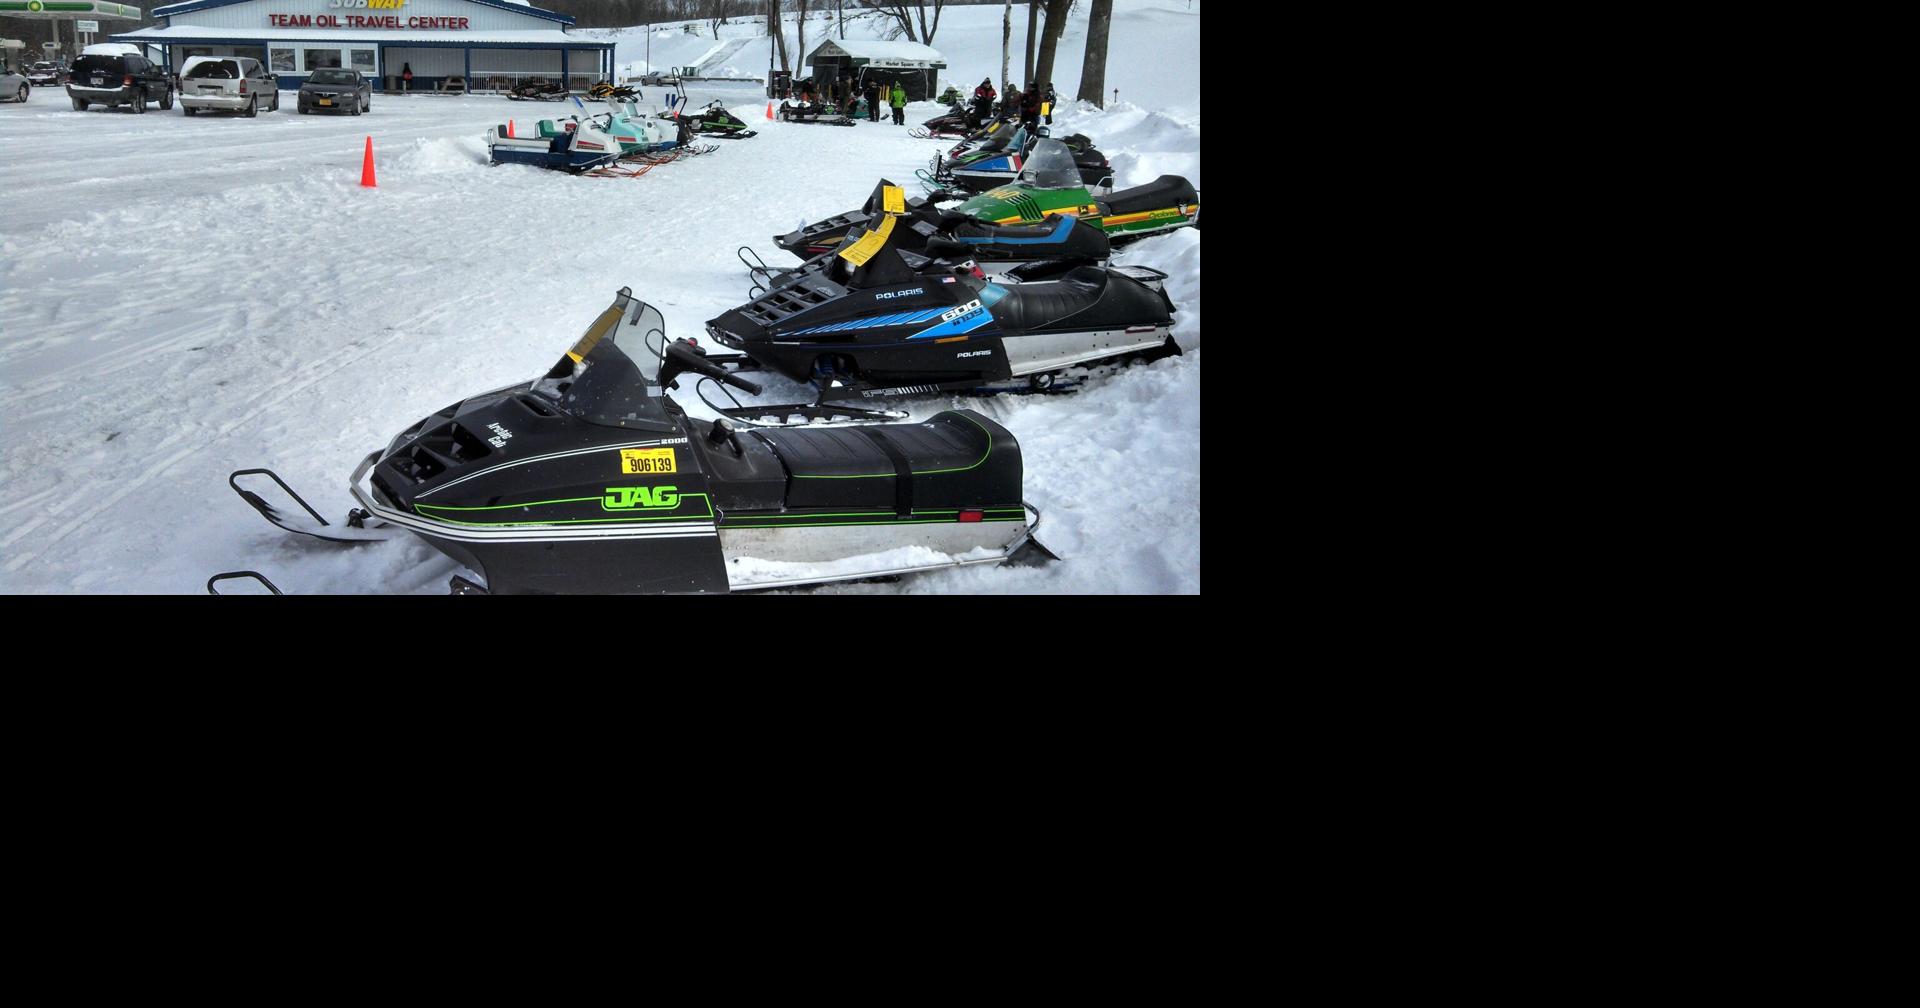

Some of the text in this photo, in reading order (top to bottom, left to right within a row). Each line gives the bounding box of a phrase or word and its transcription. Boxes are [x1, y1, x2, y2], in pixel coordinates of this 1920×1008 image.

[269, 14, 469, 30] TEAM OIL TRAVEL CENTER
[875, 287, 924, 300] POLARIS
[941, 299, 981, 322] 600
[956, 349, 992, 358] POLARIS
[488, 435, 507, 448] Cat
[660, 437, 688, 445] 2000
[630, 458, 672, 473] 906139
[605, 485, 678, 508] JAG
